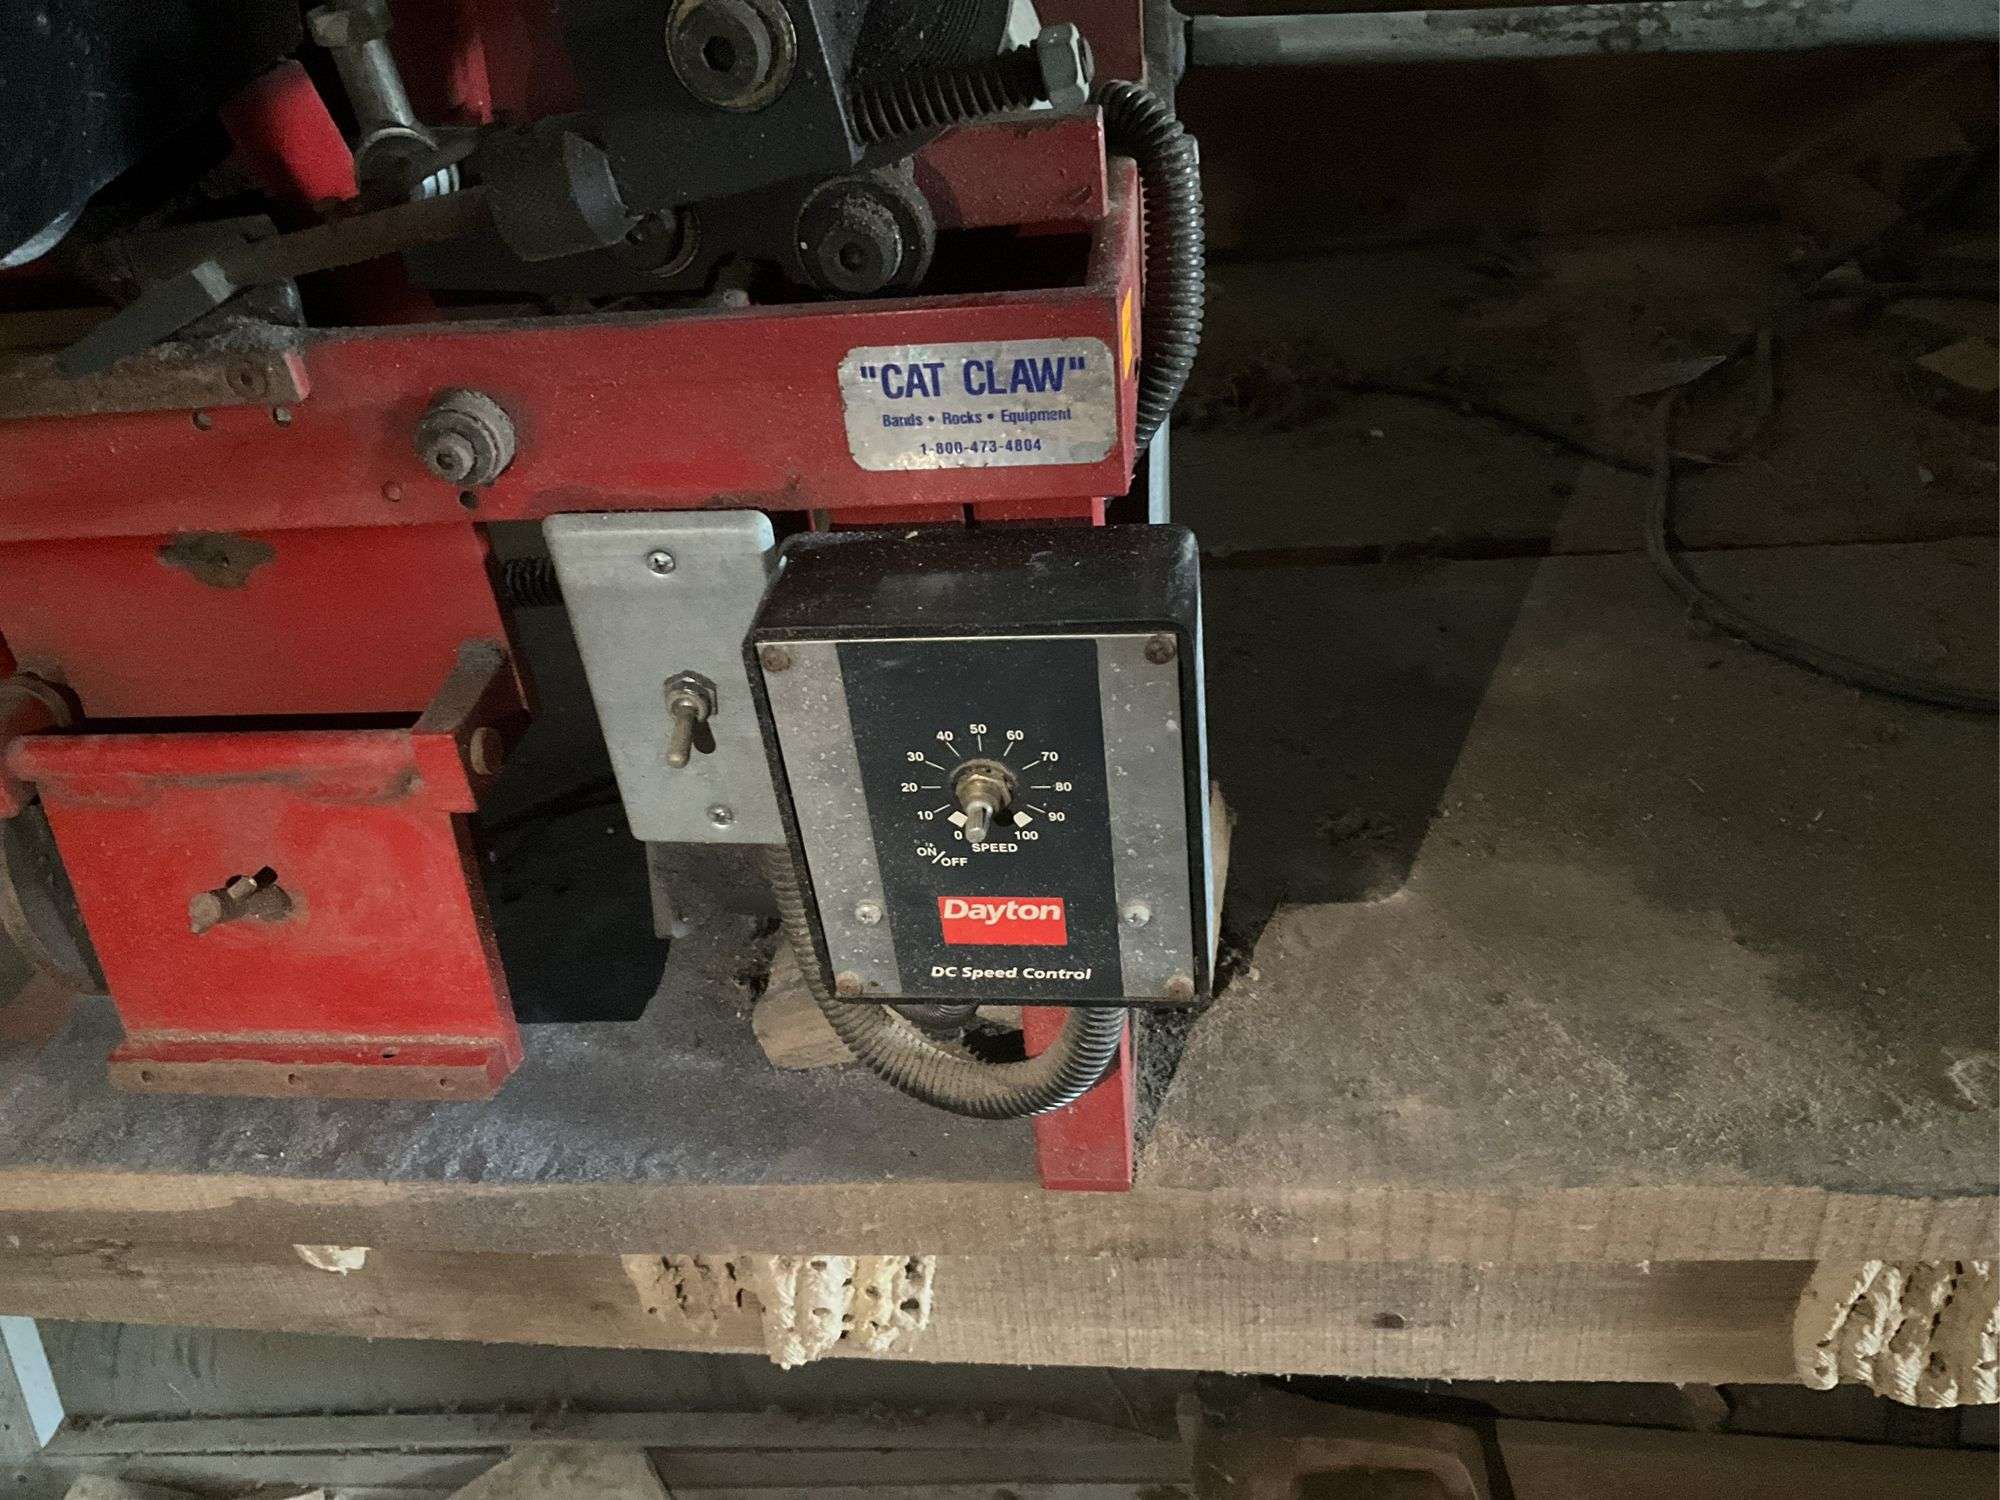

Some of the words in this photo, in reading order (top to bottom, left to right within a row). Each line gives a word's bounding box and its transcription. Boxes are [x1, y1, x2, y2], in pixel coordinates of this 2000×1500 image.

[860, 362, 945, 400] "CAT
[963, 356, 1085, 396] CLAW"
[882, 413, 923, 427] Bands
[1001, 408, 1072, 424] Equipment
[969, 724, 987, 734] 50
[936, 731, 954, 741] 40
[1006, 730, 1024, 741] 60
[907, 752, 924, 762] 30
[1041, 752, 1059, 762] 70
[901, 782, 918, 792] 20
[1055, 782, 1072, 792] 80
[917, 811, 933, 821] 10
[1048, 812, 1065, 822] 90
[953, 830, 963, 840] 0
[1014, 830, 1039, 840] 100
[971, 843, 1018, 853] SPEED
[943, 899, 1062, 925] Dayton
[931, 966, 957, 978] DC
[961, 966, 1018, 980] Speed
[1022, 968, 1092, 980] Control
